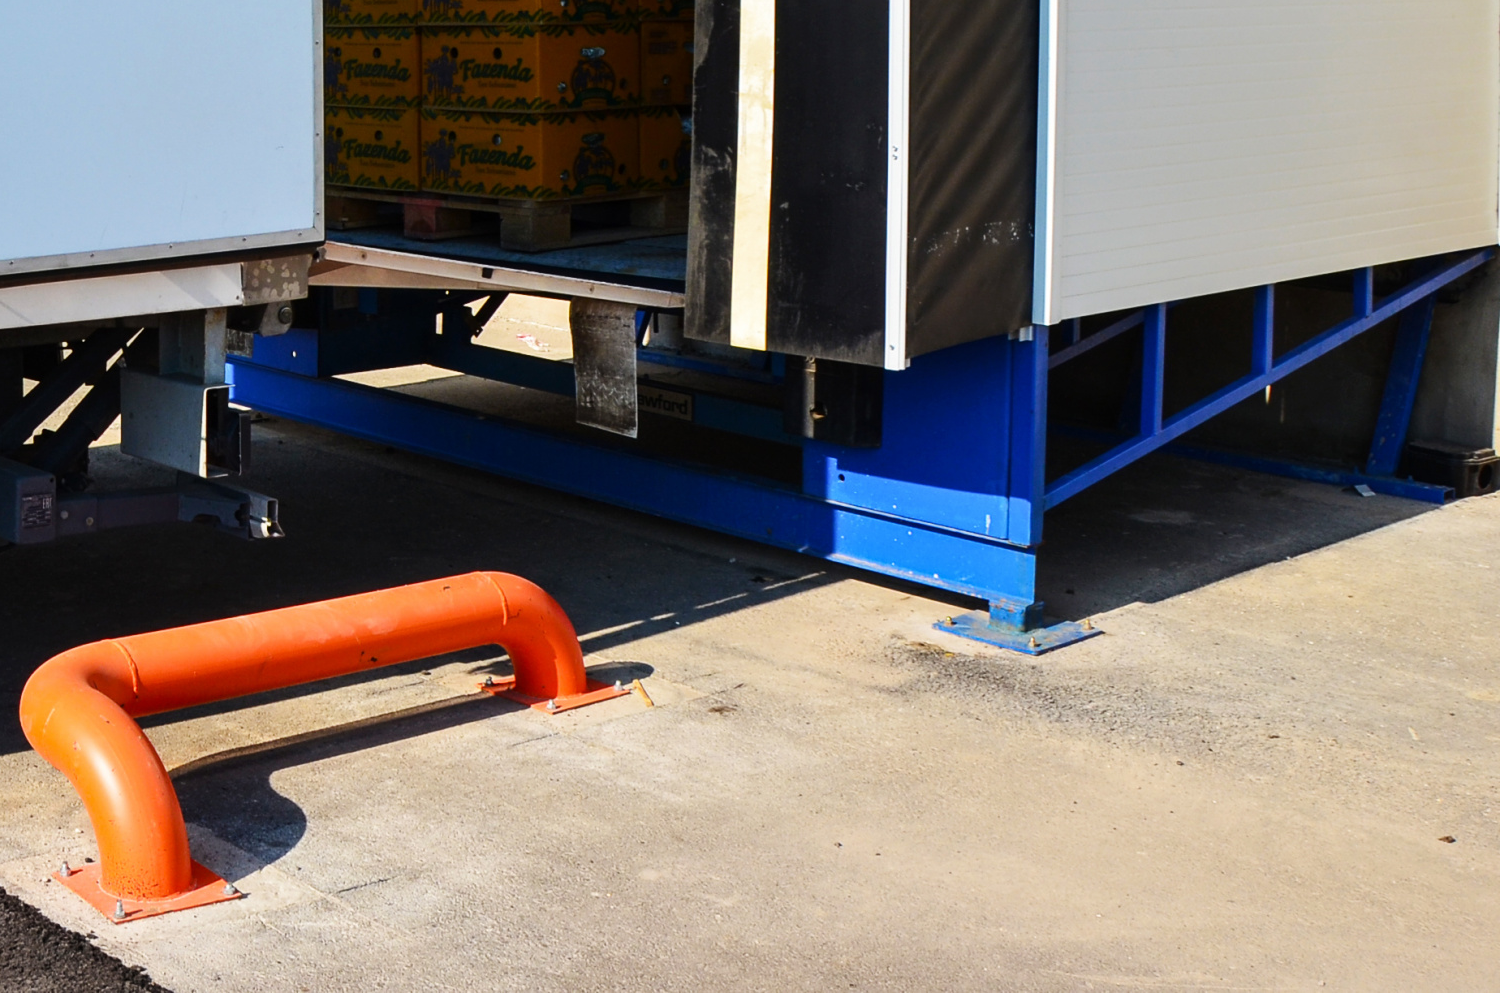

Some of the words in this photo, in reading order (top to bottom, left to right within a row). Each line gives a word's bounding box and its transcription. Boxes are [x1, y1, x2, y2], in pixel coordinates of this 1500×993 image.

[343, 59, 412, 83] Fazenda
[460, 58, 535, 83] Fazenda
[343, 140, 412, 164] Fazenda
[457, 145, 536, 171] Fazenda
[637, 394, 688, 415] awford
